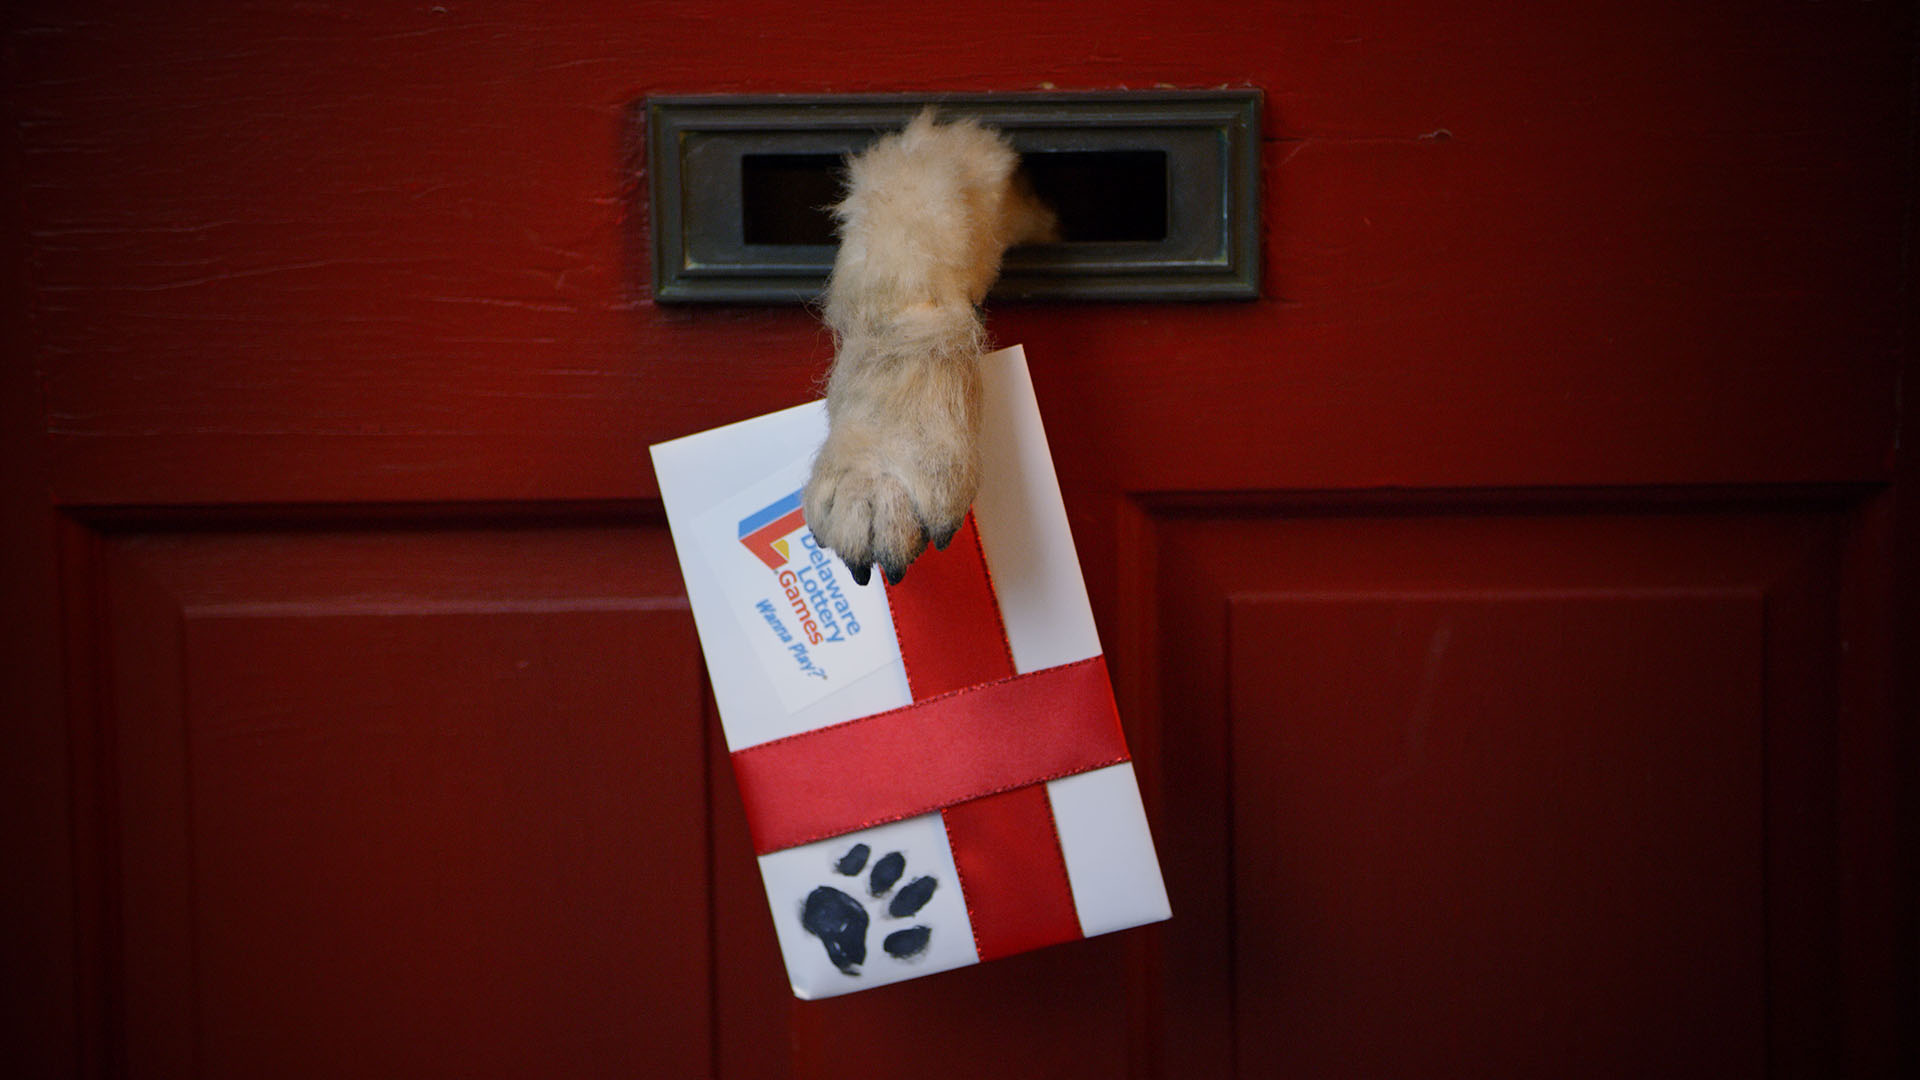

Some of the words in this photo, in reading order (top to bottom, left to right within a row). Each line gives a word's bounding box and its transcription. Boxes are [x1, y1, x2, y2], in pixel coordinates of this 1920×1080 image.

[779, 570, 824, 645] Games
[797, 566, 844, 643] Lottery
[801, 533, 860, 635] Delaware
[755, 598, 792, 643] Wanna
[788, 641, 826, 679] Play?
